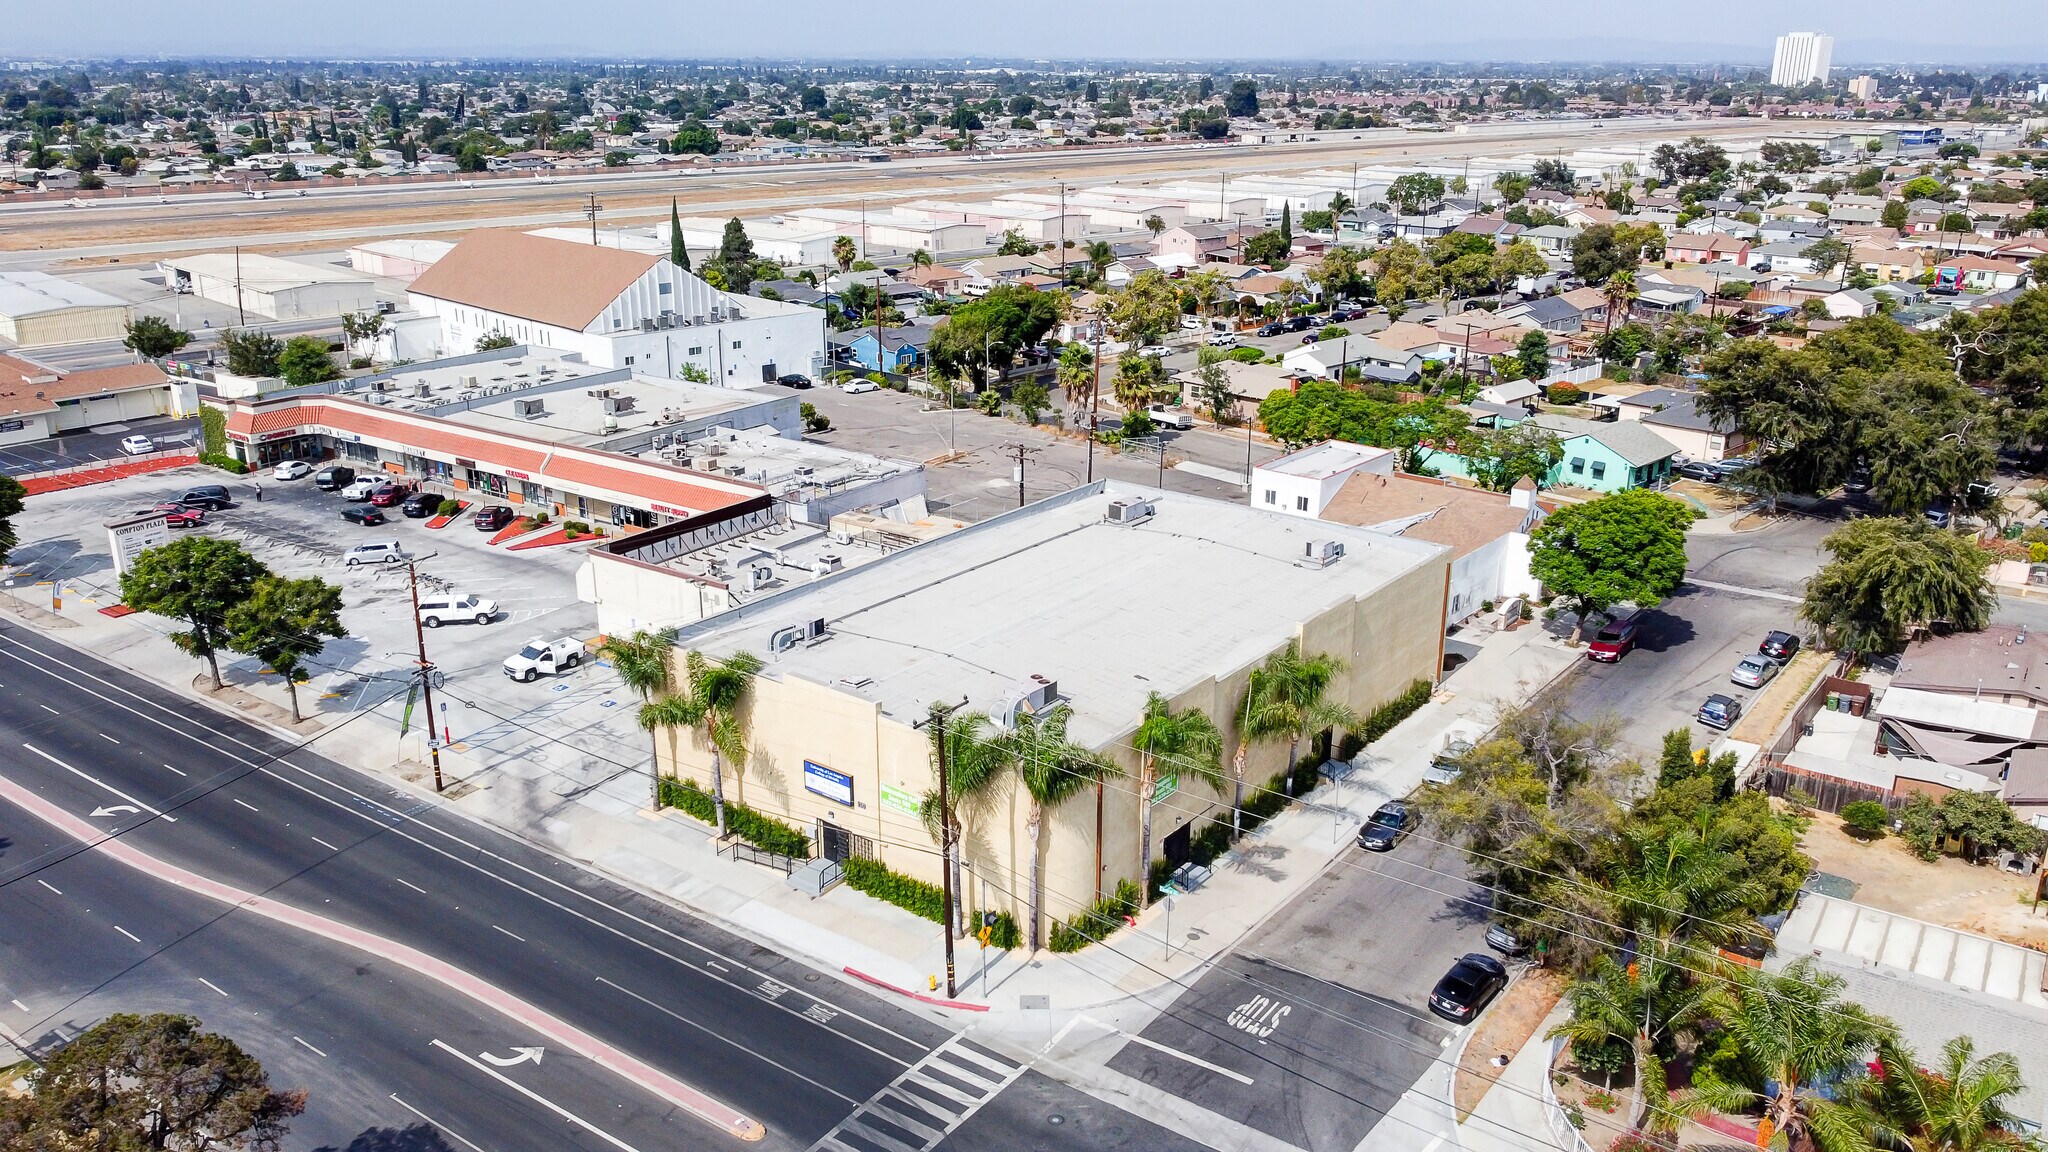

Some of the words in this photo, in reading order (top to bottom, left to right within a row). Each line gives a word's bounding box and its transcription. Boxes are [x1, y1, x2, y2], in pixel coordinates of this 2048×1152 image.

[115, 524, 145, 536] COMPTON
[145, 519, 165, 530] PLAZA
[1227, 994, 1292, 1038] STOP
